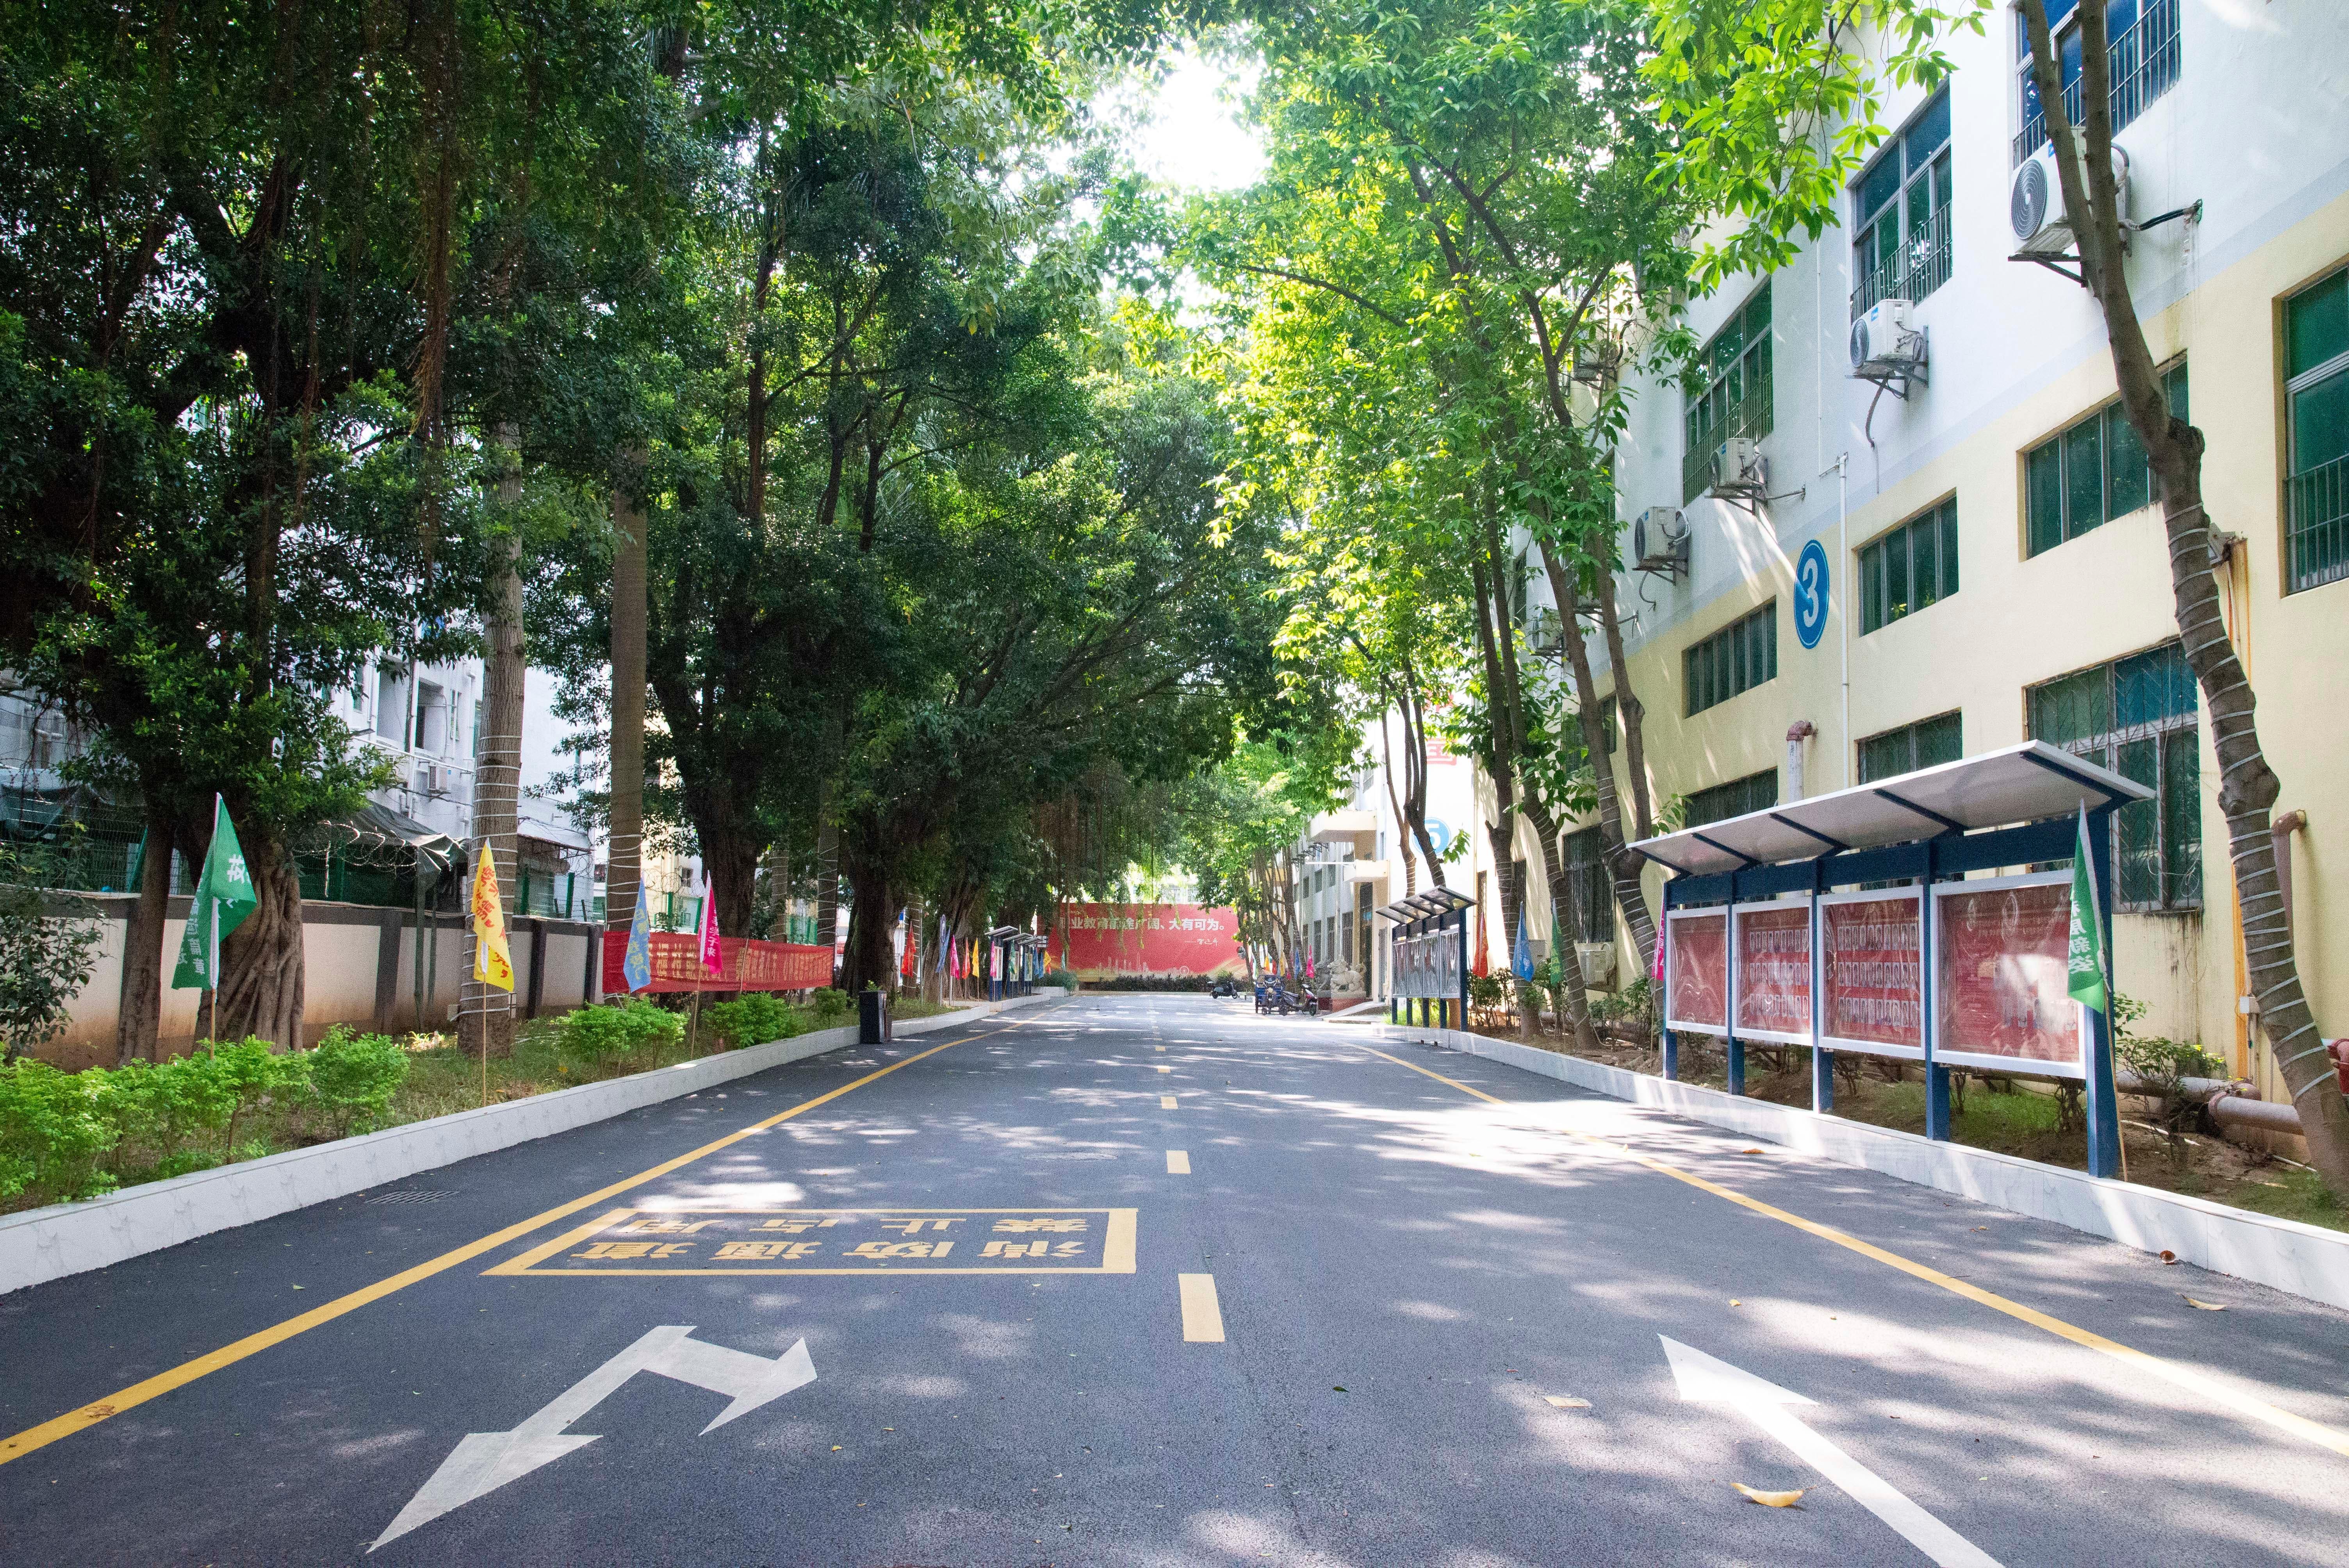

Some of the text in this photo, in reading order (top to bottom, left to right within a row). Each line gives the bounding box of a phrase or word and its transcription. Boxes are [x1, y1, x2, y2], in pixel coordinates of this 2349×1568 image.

[1802, 558, 1819, 628] 3
[1425, 823, 1441, 849] 5
[615, 1218, 1089, 1234] 禁止占用
[569, 1240, 1087, 1260] 消防通道
